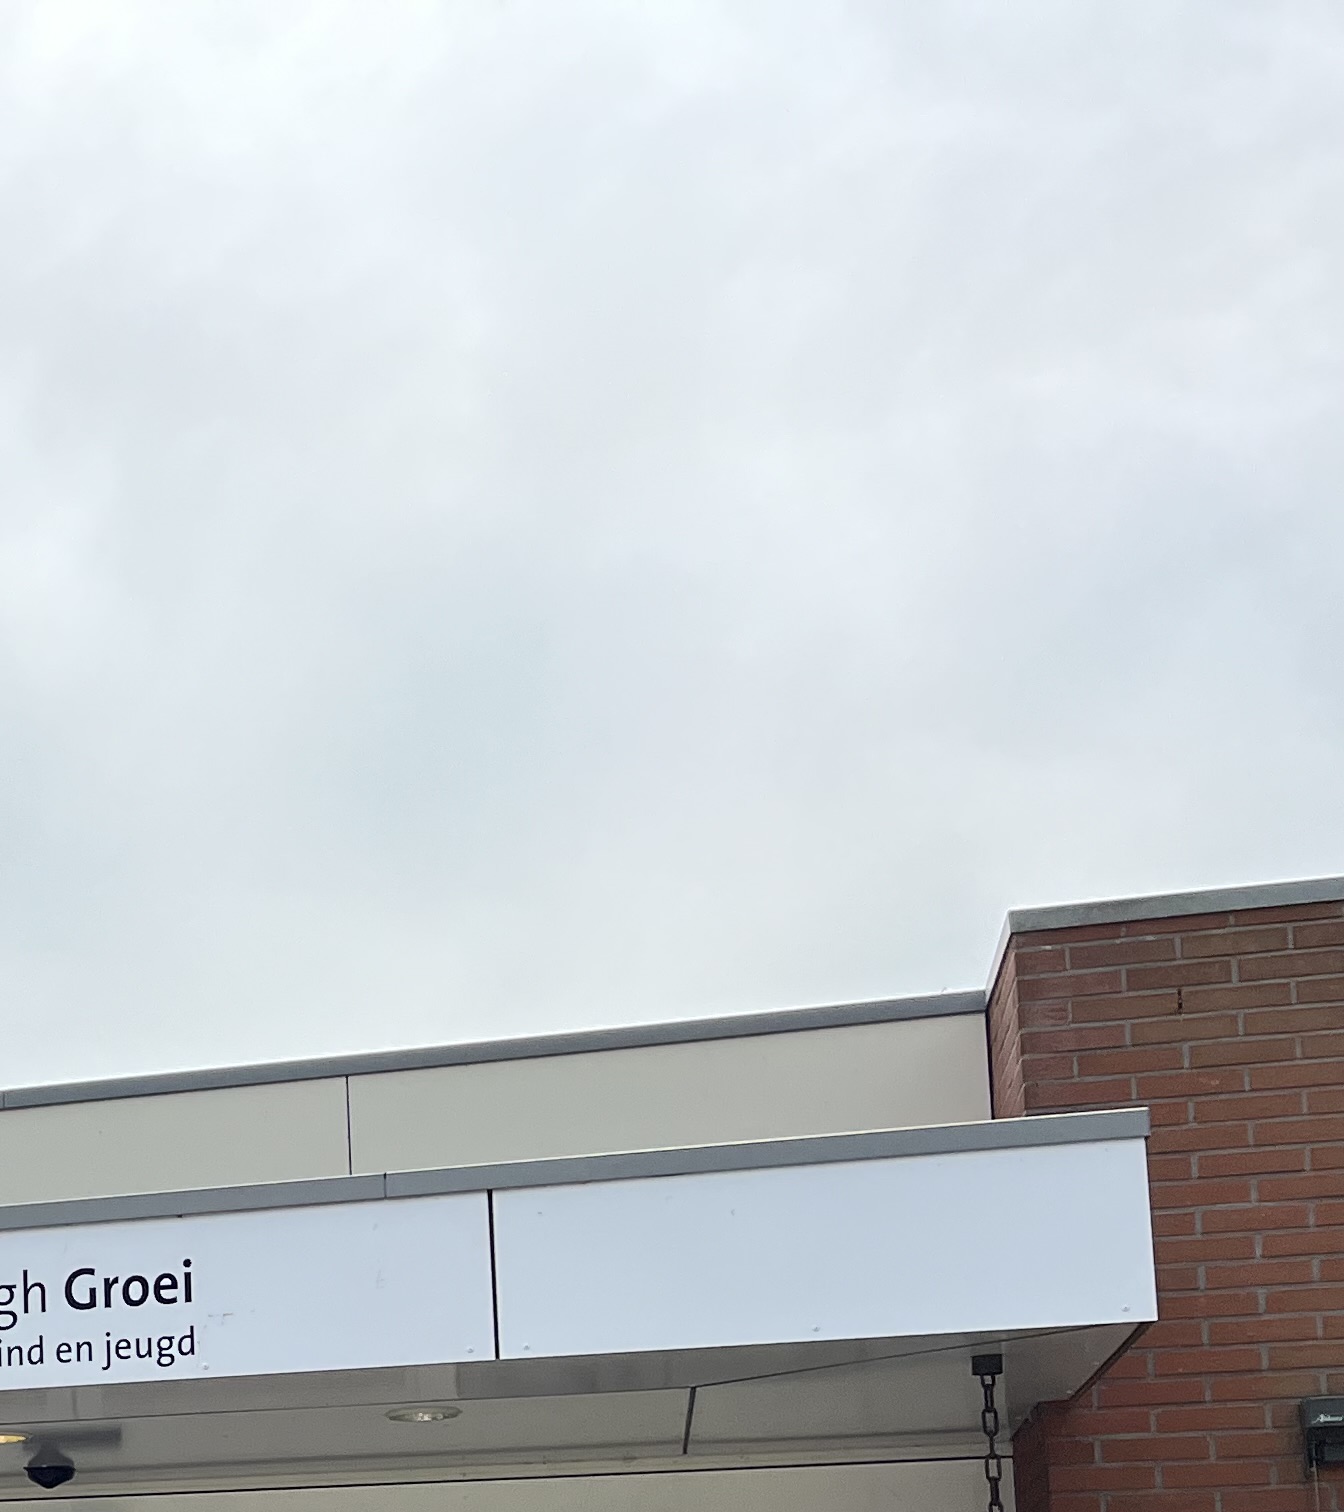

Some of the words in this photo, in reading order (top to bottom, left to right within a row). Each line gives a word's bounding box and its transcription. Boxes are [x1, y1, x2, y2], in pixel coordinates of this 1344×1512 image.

[64, 1258, 193, 1311] Groei
[55, 1341, 93, 1364] en
[101, 1325, 196, 1371] jeugd
